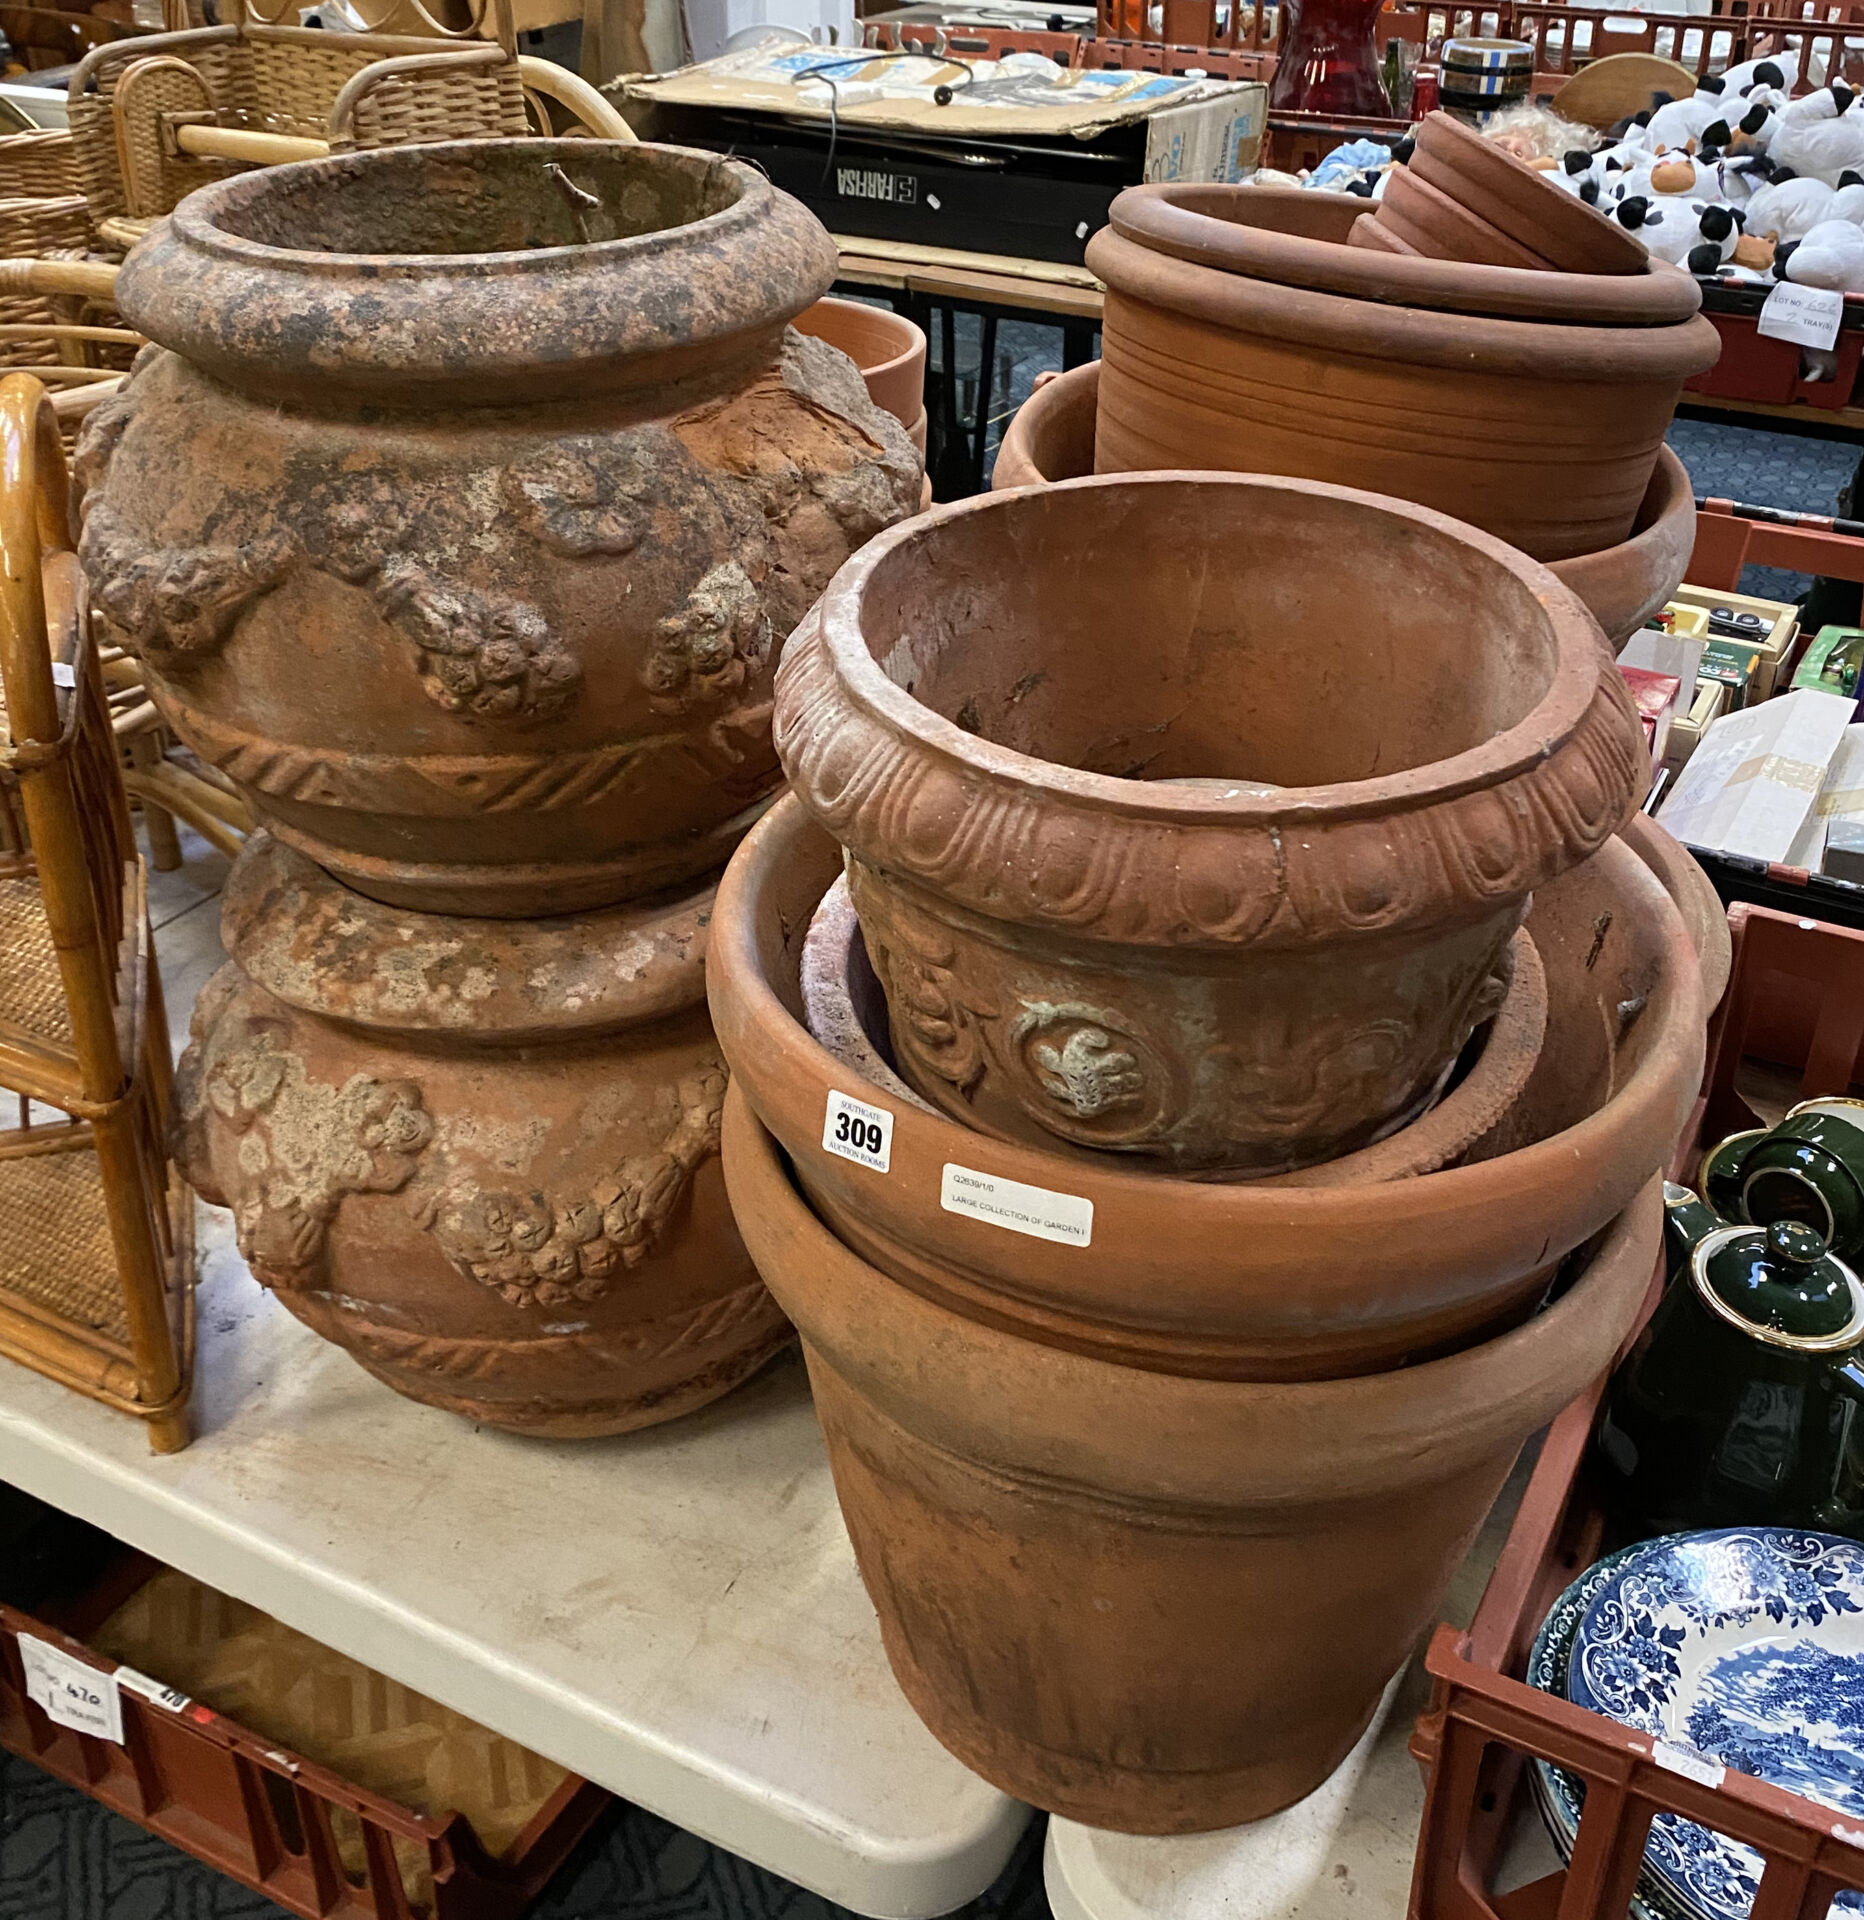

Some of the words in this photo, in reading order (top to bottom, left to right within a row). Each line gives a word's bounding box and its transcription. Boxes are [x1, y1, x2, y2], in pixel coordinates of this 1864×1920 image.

[837, 167, 893, 200] FARFISA
[1774, 296, 1788, 305] LOT
[841, 1100, 882, 1122] SOUTHGATE
[835, 1111, 882, 1154] 309
[828, 1141, 860, 1159] AUCTION
[860, 1153, 886, 1169] ROOMS
[951, 1194, 978, 1208] LARGE
[979, 1202, 1029, 1223] COLLECTION
[1030, 1215, 1041, 1225] OF
[1044, 1220, 1080, 1236] GARDEN
[66, 1682, 101, 1706] 470
